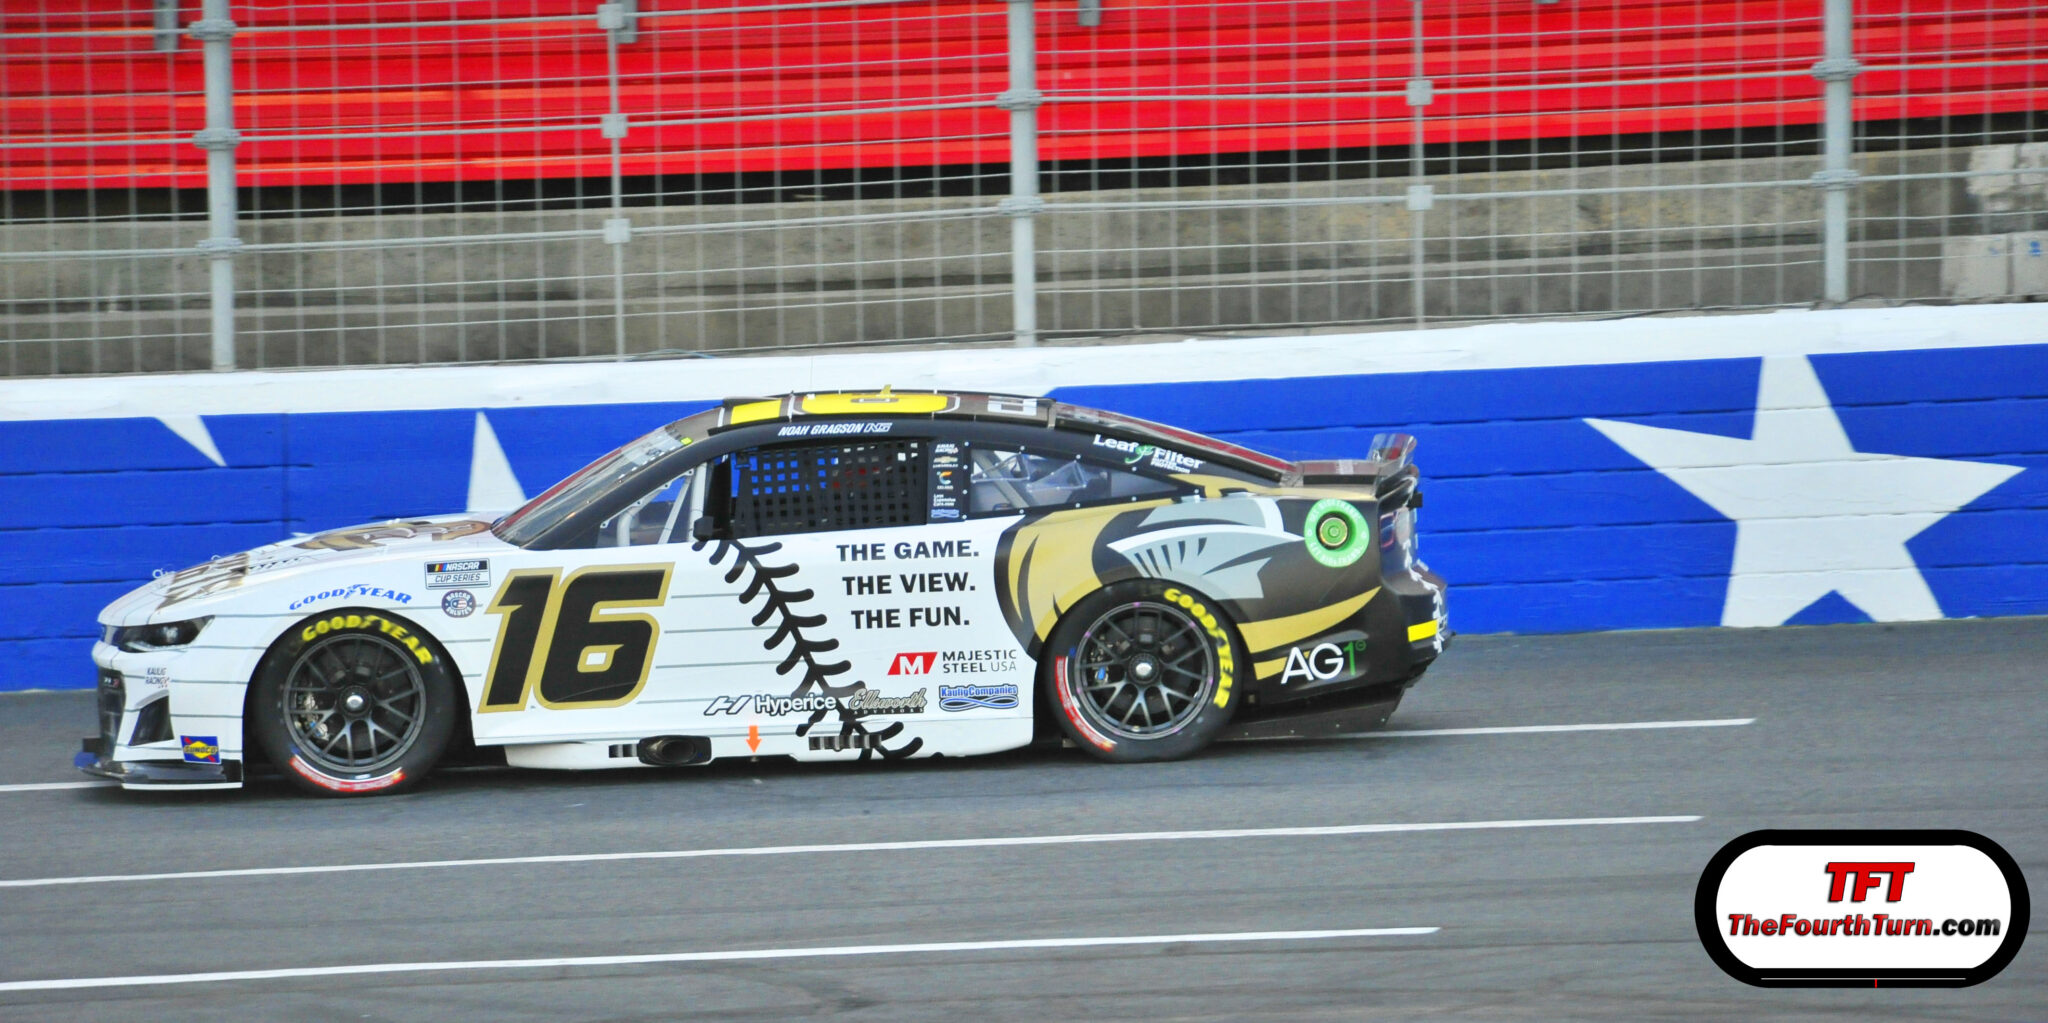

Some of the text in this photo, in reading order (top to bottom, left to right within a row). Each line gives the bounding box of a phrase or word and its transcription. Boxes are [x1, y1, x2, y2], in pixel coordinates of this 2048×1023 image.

[777, 425, 811, 437] NOAH
[810, 422, 865, 435] GRAGSON
[836, 540, 979, 562] THE GAME.
[446, 561, 480, 571] NASCAR
[435, 573, 481, 583] CUP SERIES
[842, 572, 976, 595] THE VIEW.
[851, 606, 970, 629] THE FUN.
[477, 561, 675, 713] 16
[942, 649, 1017, 662] MAJESTIC
[942, 661, 1017, 674] STEEL USA
[754, 692, 837, 716] Hyperice
[848, 688, 928, 710] Ellsworth
[184, 745, 219, 755] SUNOCO
